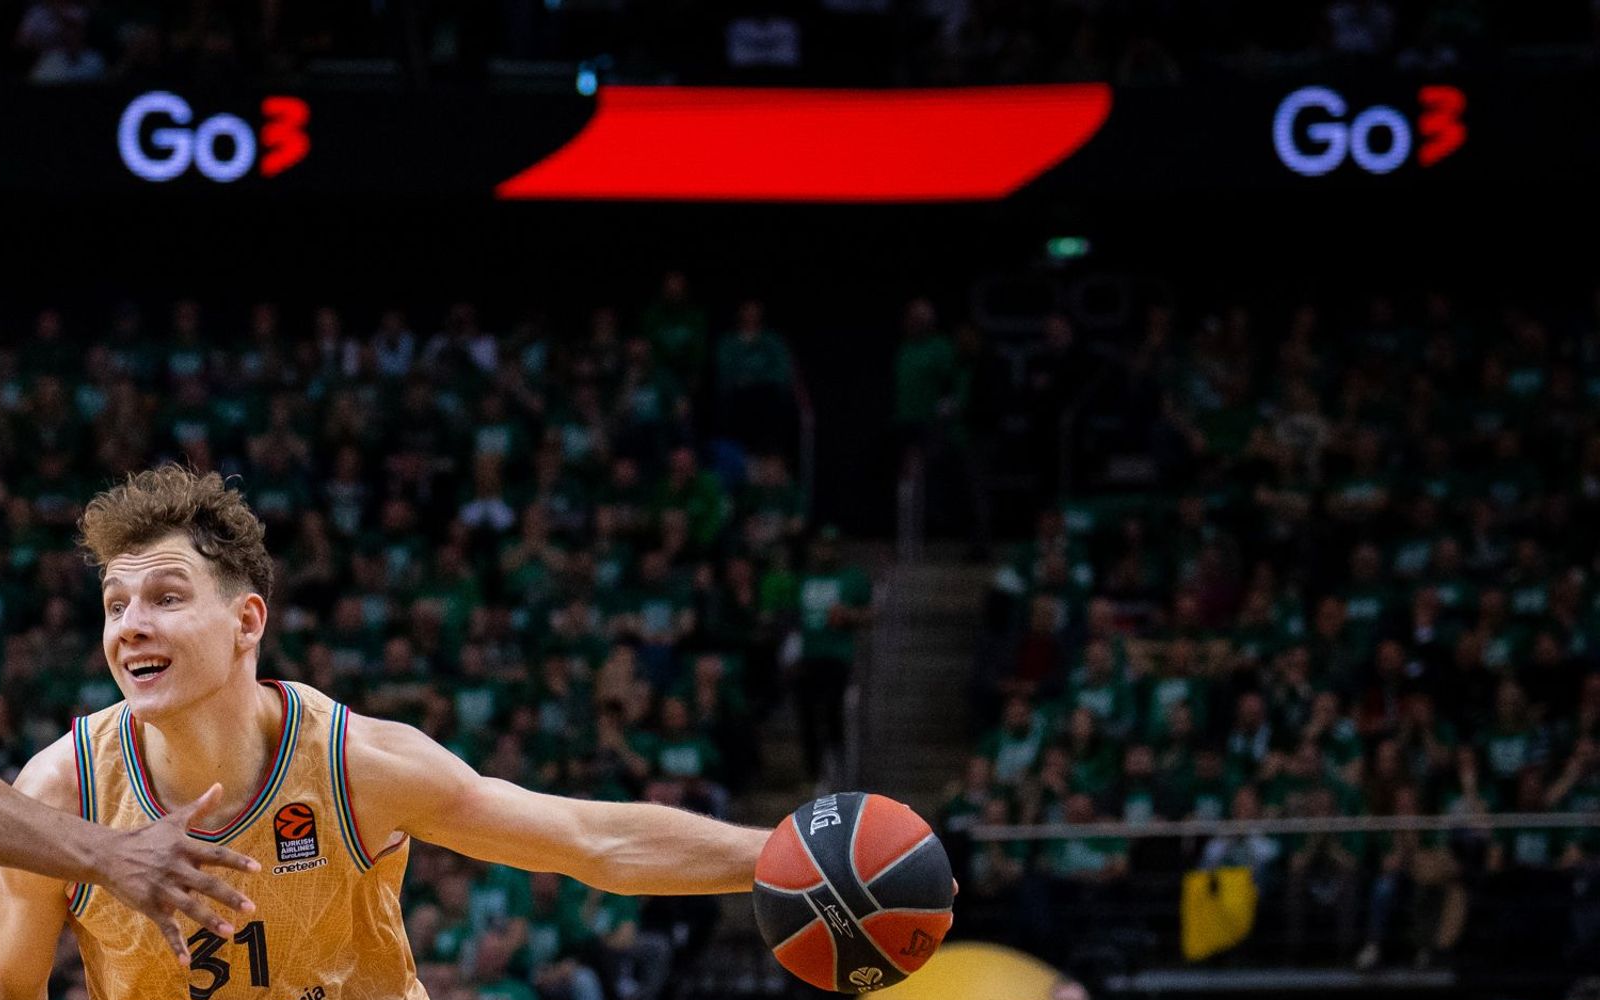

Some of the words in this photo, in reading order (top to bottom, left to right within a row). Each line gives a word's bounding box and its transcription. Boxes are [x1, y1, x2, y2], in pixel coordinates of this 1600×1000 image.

[118, 90, 310, 182] Go3
[1273, 86, 1464, 176] Go3
[280, 838, 314, 848] TURKISH
[281, 844, 315, 854] AIRLINES
[281, 850, 316, 860] EuroLeague
[273, 857, 327, 874] oneteam
